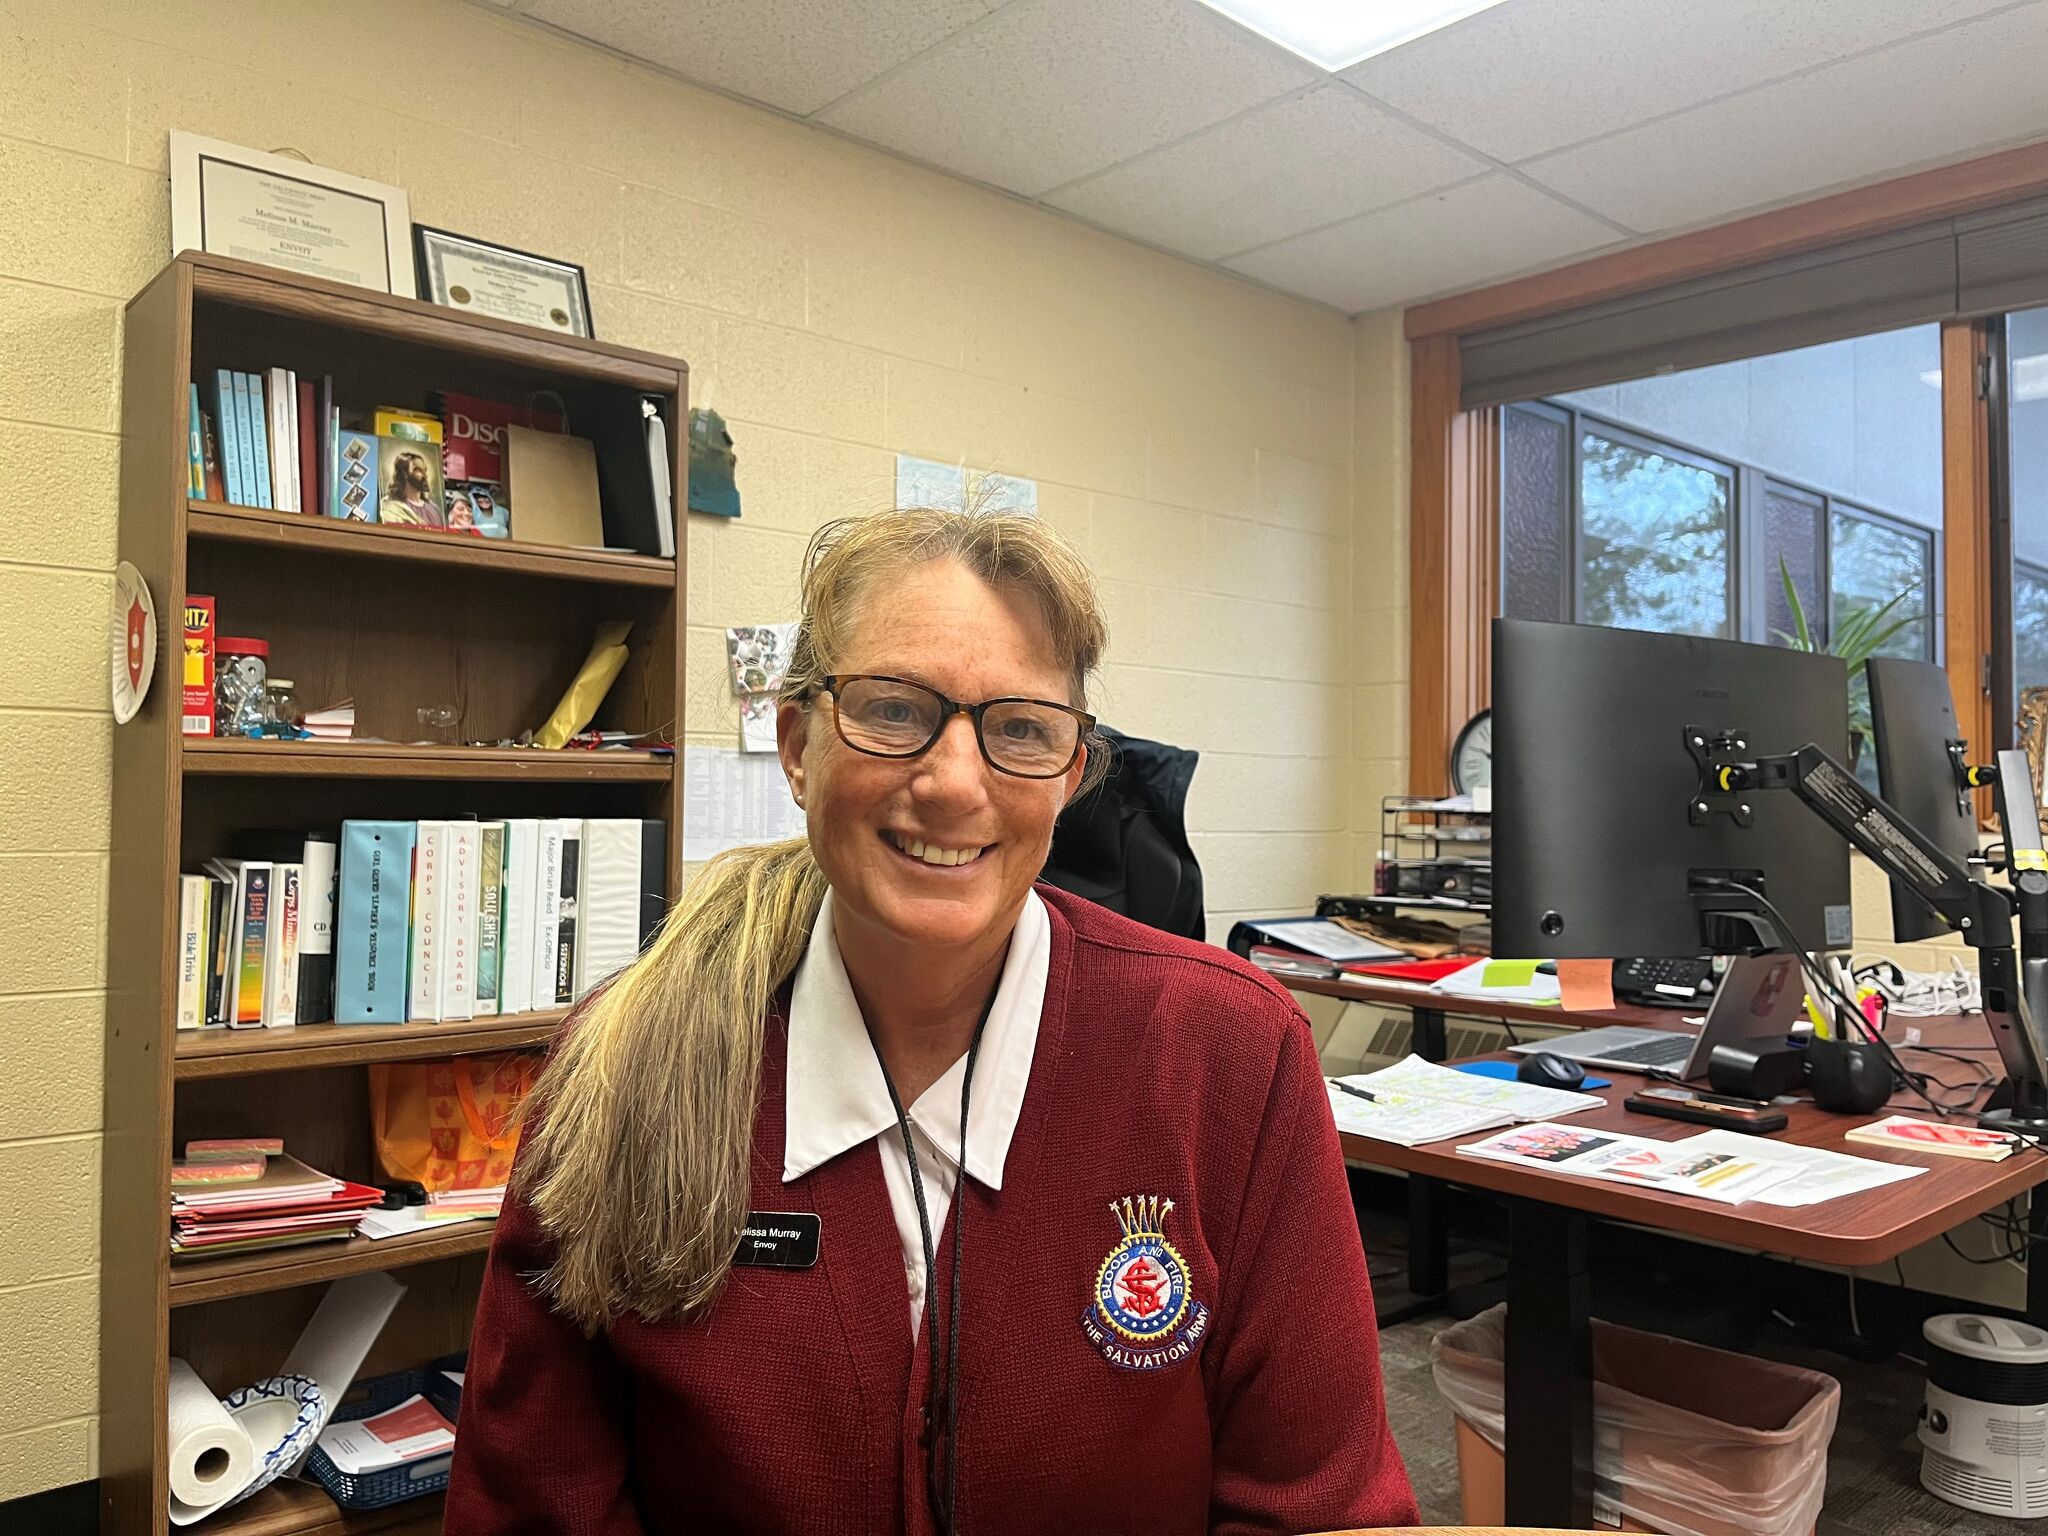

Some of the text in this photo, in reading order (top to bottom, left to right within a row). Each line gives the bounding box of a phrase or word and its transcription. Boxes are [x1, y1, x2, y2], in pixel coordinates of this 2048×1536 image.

[279, 241, 313, 256] ENVOY
[546, 837, 556, 864] Major
[546, 866, 554, 889] Brian
[284, 876, 300, 908] Corps
[546, 892, 554, 914] Reed
[423, 836, 434, 998] CORPS COUNCIL
[456, 836, 466, 992] ADVISORY BOARD
[313, 922, 327, 932] CD
[186, 932, 198, 955] Bible
[184, 955, 196, 982] Trivia
[741, 1227, 802, 1240] elissa Murray
[754, 1240, 778, 1250] Envoy
[1102, 1246, 1184, 1300] BLOOD AND FIRE
[1082, 1308, 1209, 1368] THE SALVATION ARMY
